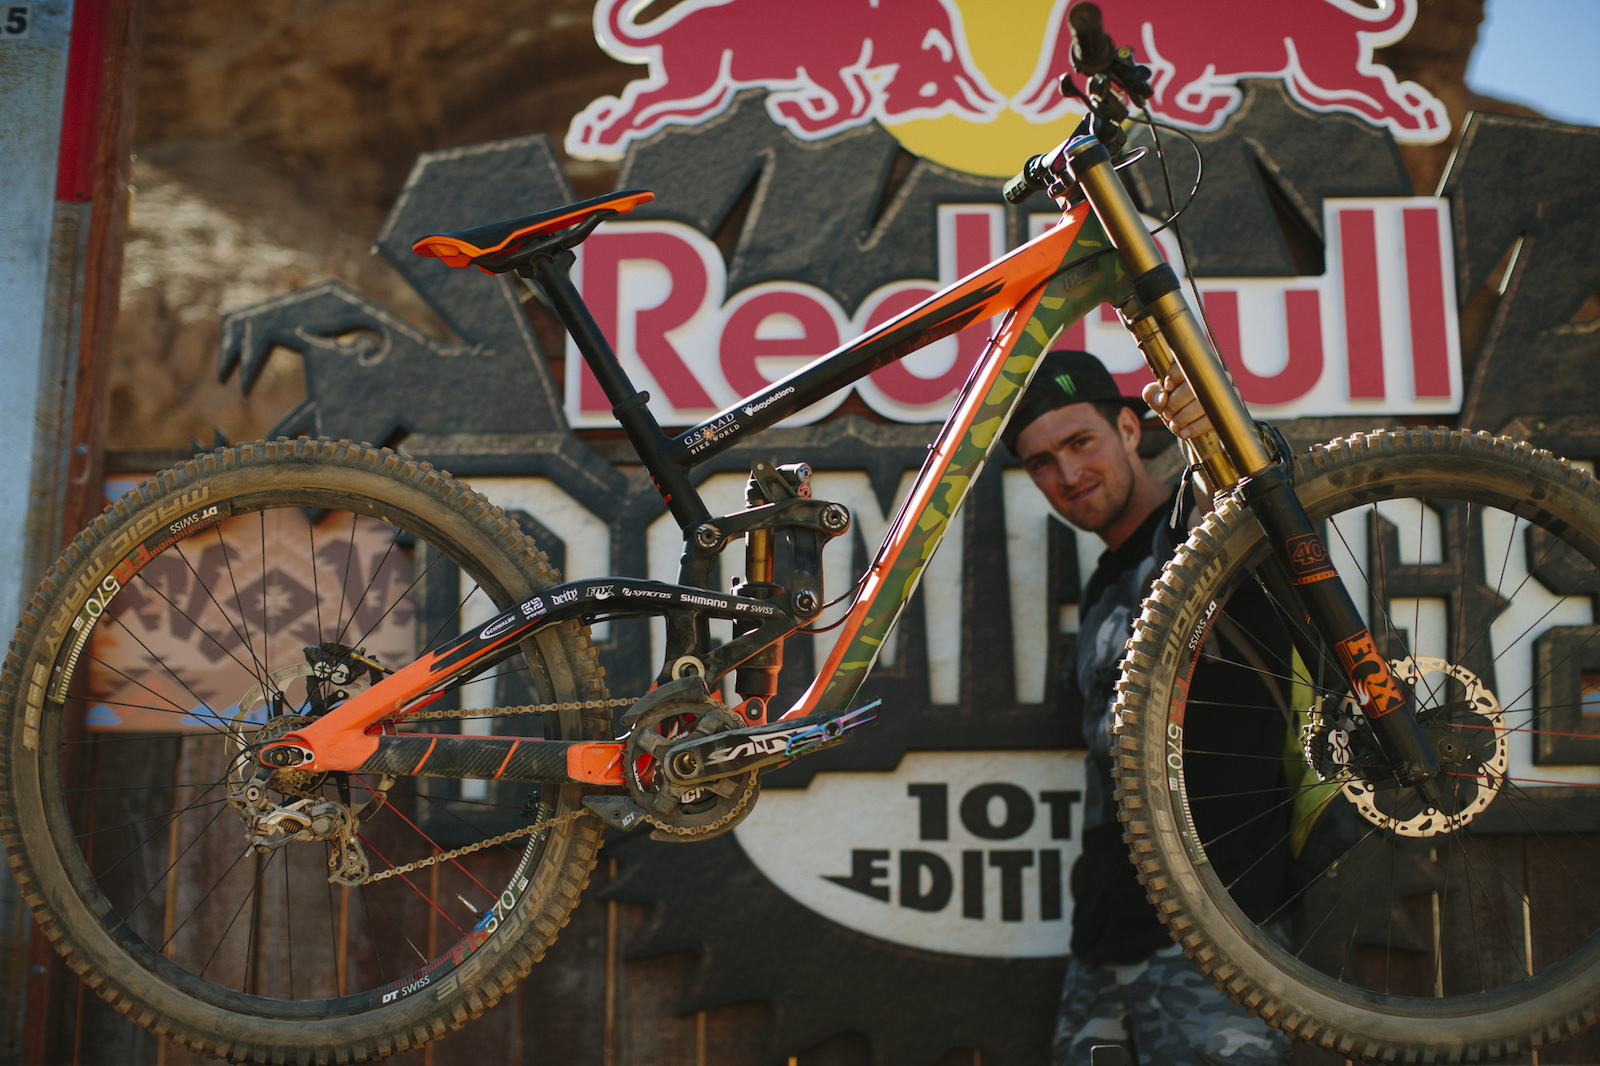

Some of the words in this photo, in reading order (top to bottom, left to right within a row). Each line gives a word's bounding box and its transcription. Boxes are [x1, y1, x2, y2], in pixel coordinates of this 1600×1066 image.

[0, 6, 28, 35] 5
[576, 210, 993, 414] Red
[1042, 206, 1452, 408] ull
[684, 412, 736, 446] GSTAAD
[690, 440, 711, 455] BIKE
[712, 424, 741, 442] WORLD
[170, 513, 200, 535] SWISS
[202, 505, 219, 520] DT
[1291, 538, 1328, 566] 40
[1300, 571, 1336, 584] FACTORY
[85, 575, 121, 618] 570
[551, 587, 578, 606] deity
[585, 584, 615, 601] FOX
[632, 588, 673, 600] syncros
[680, 593, 728, 609] SHIMANO
[735, 602, 750, 612] DT
[750, 604, 775, 615] SWISS
[1205, 600, 1218, 620] DT
[485, 614, 517, 637] SCHWALBE
[1188, 618, 1207, 651] SWISS
[1346, 631, 1403, 712] FOX
[1167, 722, 1184, 770] 570
[907, 781, 1083, 842] 10T
[818, 848, 1076, 923] EDITI
[484, 889, 516, 934] 570
[382, 990, 399, 1004] DT
[401, 975, 431, 997] SWISS
